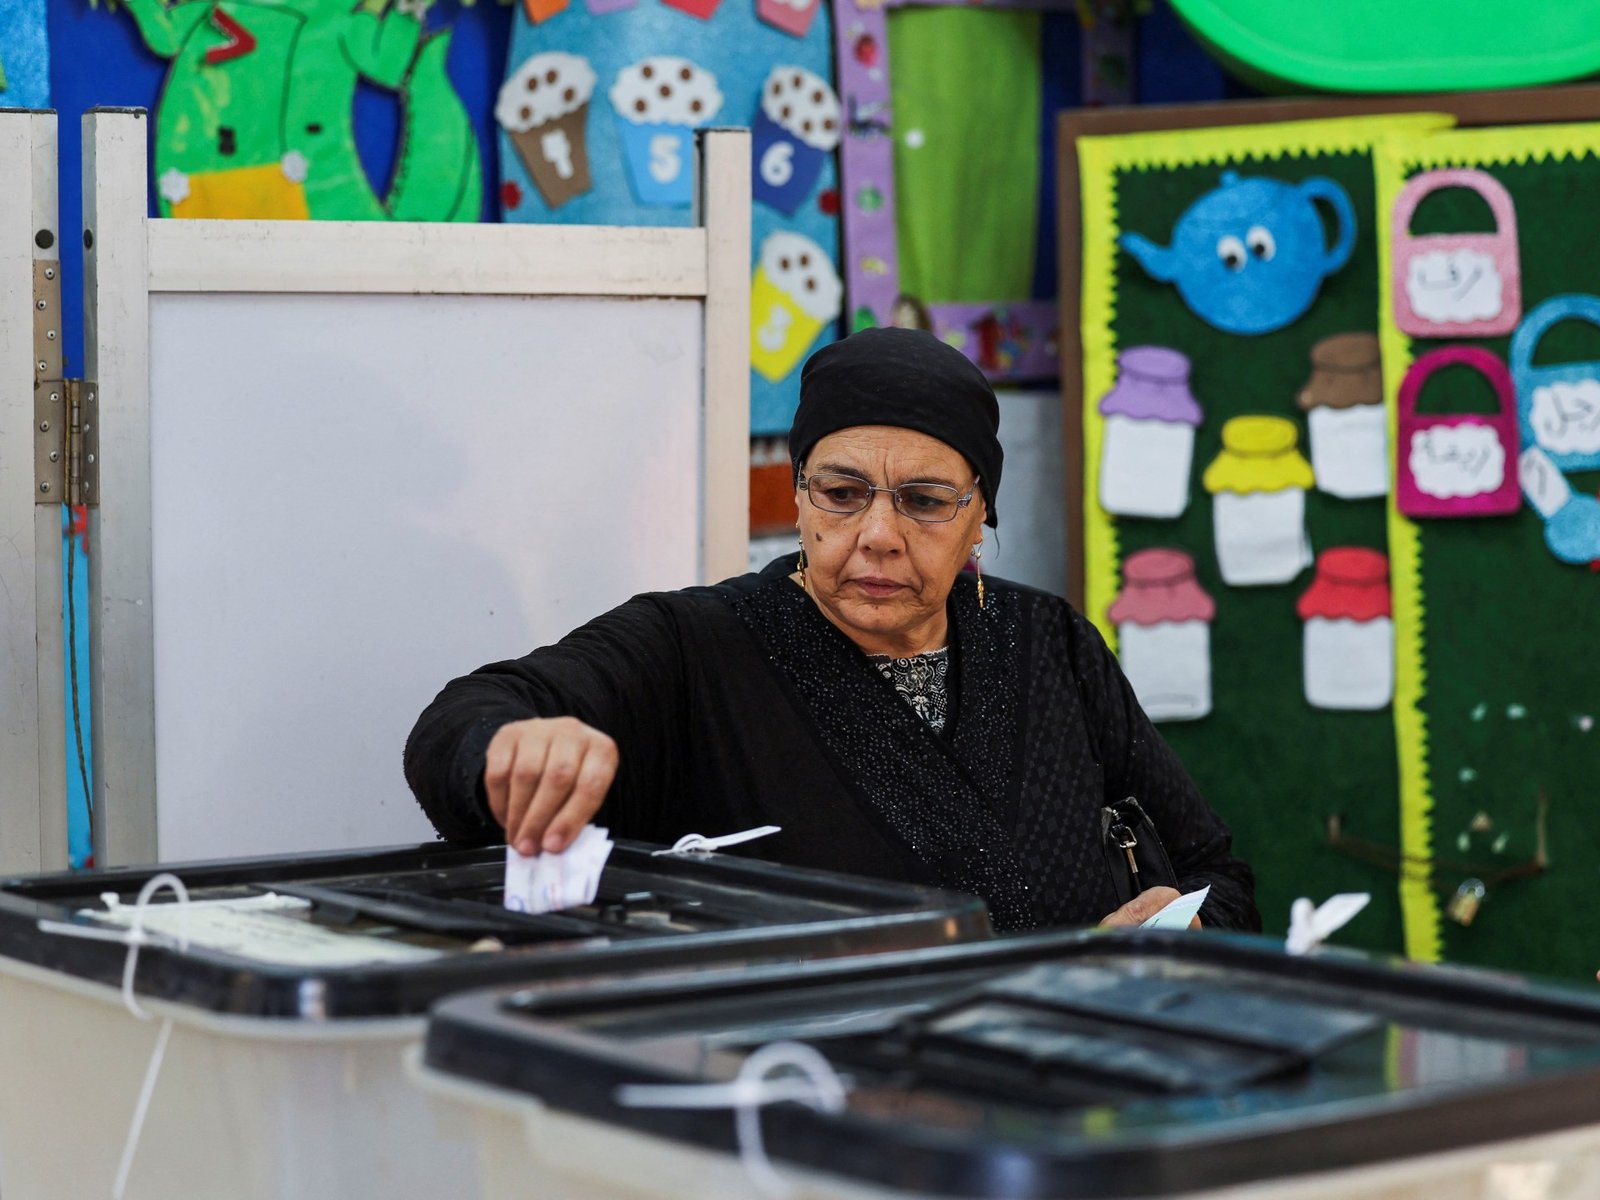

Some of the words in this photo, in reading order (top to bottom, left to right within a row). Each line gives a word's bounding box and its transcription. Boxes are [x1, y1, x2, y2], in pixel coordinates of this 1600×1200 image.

[650, 134, 682, 184] 5
[760, 141, 795, 187] 6
[757, 304, 793, 352] 3
